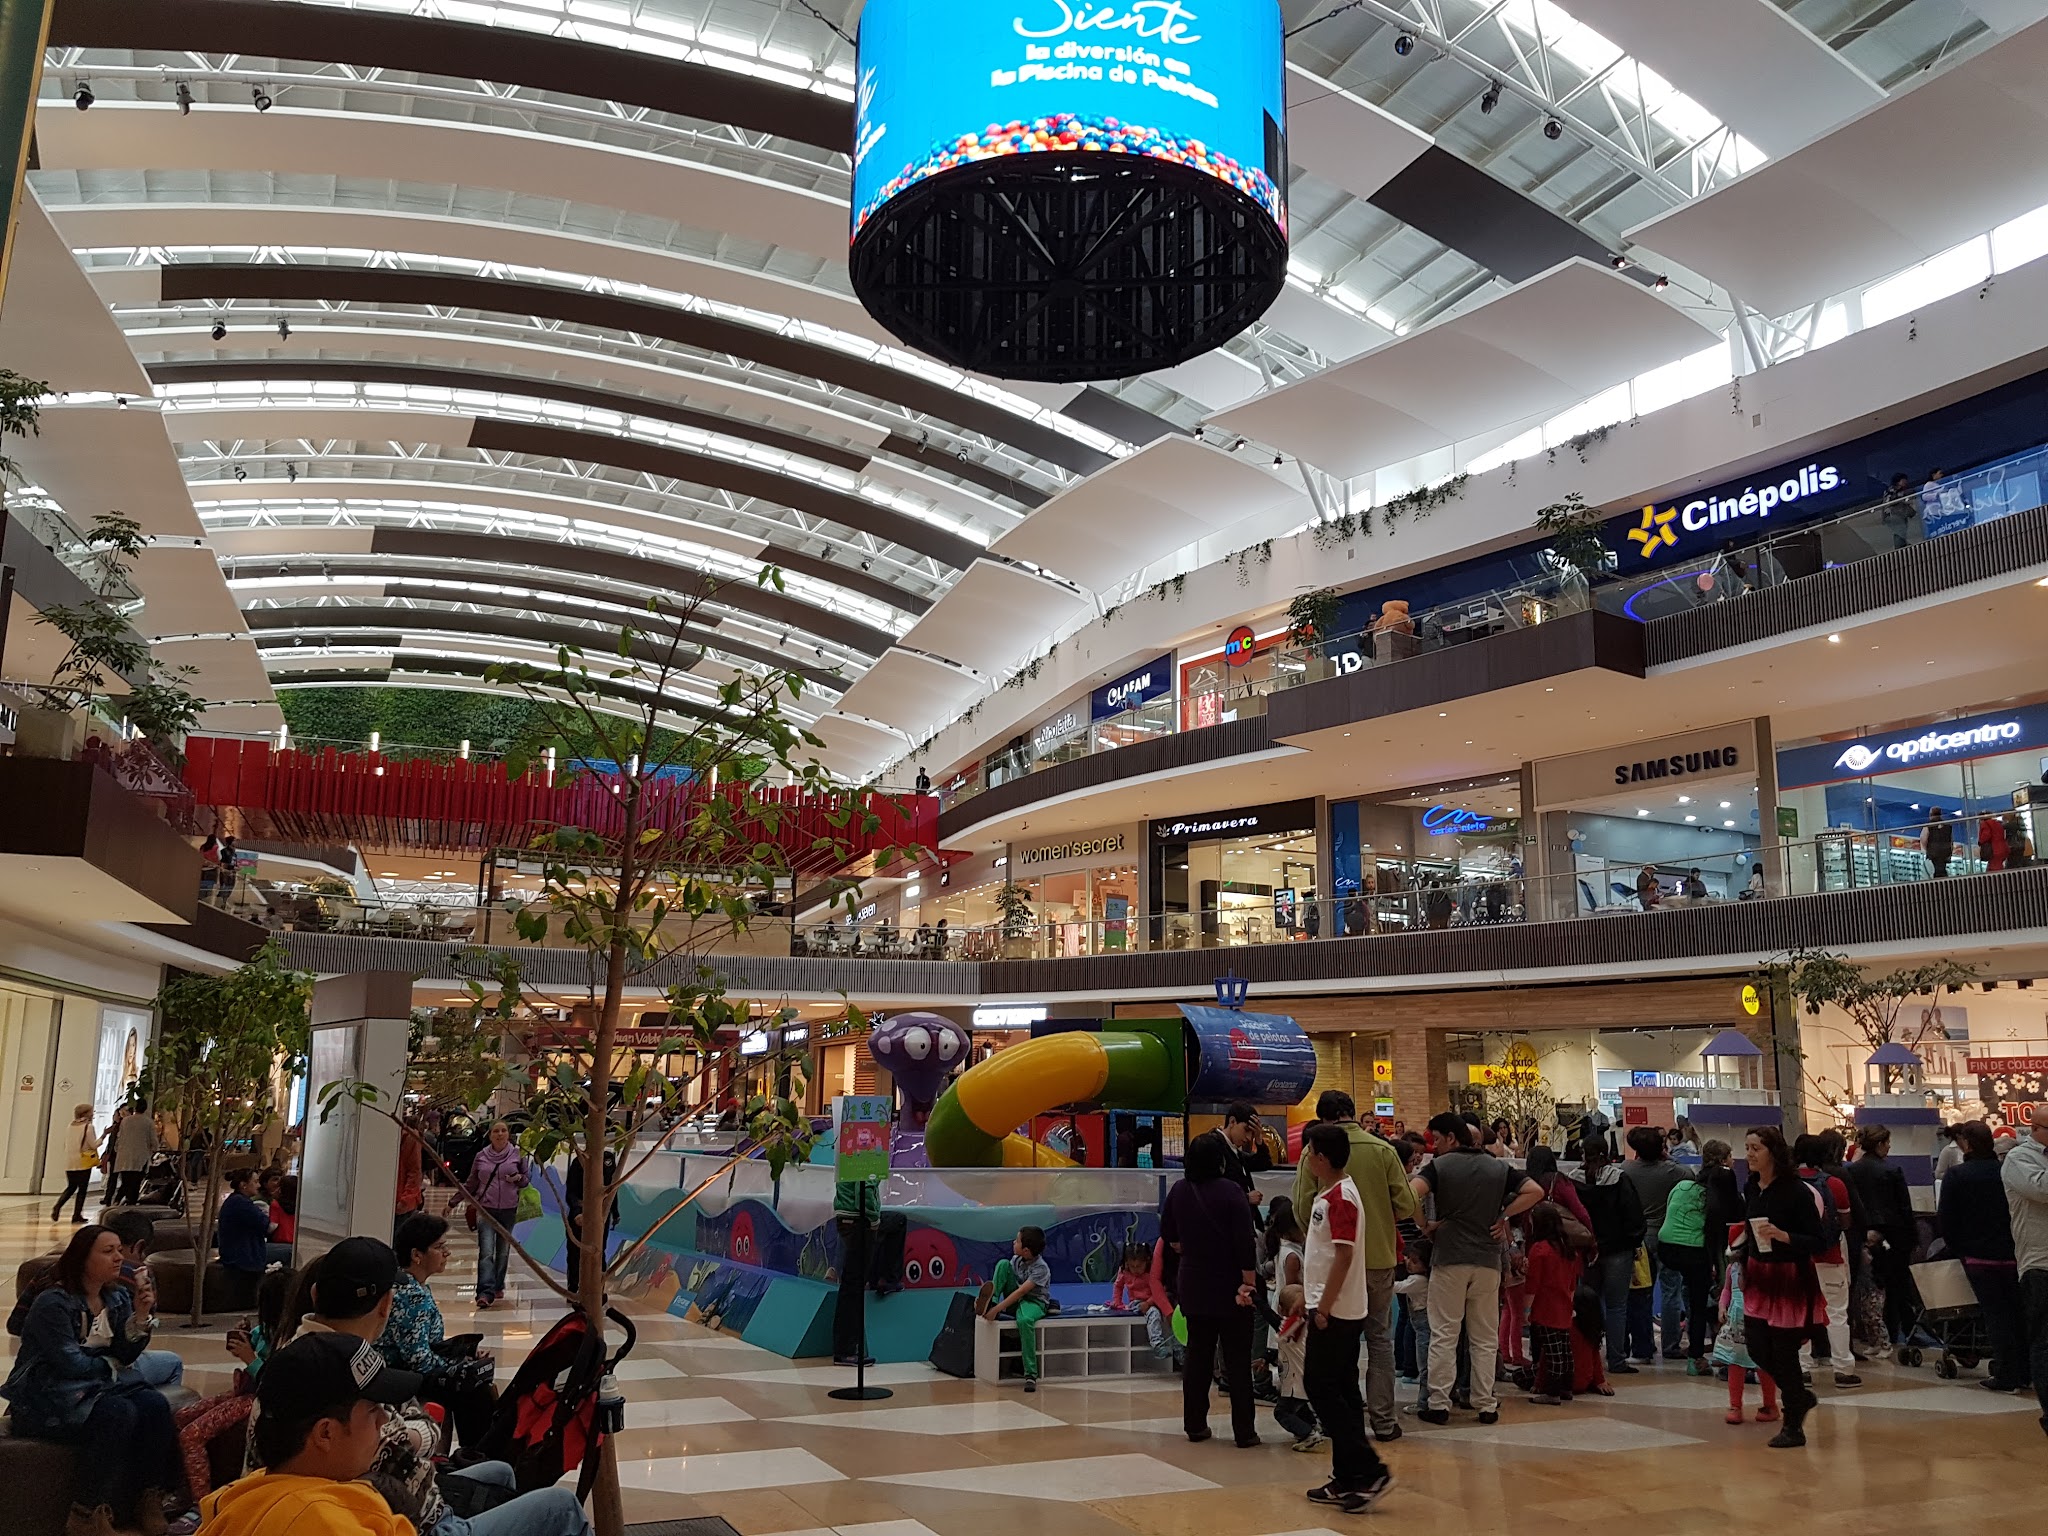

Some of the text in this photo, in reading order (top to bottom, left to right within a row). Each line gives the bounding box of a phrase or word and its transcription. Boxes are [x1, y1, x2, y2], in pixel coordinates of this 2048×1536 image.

[1012, 0, 1202, 44] Siente
[1026, 44, 1050, 60] la
[1053, 41, 1160, 67] diversión
[1018, 62, 1103, 83] Piscina
[1108, 64, 1137, 84] de
[1886, 722, 2020, 762] opticentro
[1912, 737, 2022, 761] INTERNACIONAL
[1614, 746, 1738, 785] SAMSUNG
[1171, 816, 1259, 836] Primavera
[1019, 833, 1125, 864] women'secret
[1248, 1030, 1291, 1044] de pelotas
[1970, 1059, 2048, 1071] FIN DE COLECC
[1621, 1087, 1669, 1096] ESPRIT
[2001, 1101, 2048, 1126] TO
